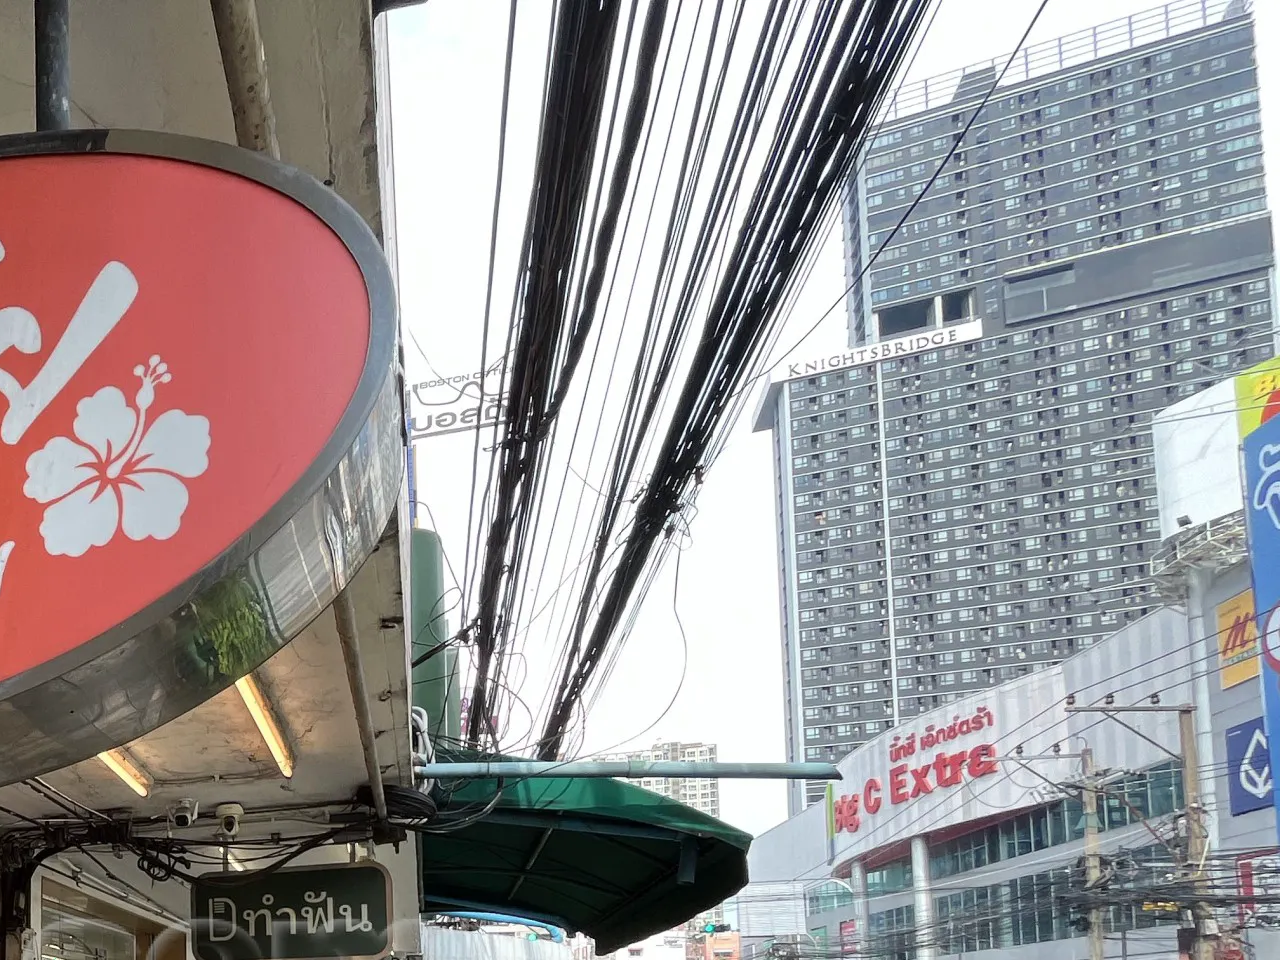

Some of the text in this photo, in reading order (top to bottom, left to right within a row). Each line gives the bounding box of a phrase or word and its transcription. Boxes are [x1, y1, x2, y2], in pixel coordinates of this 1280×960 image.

[787, 329, 958, 378] KNIGHTSBRIDGE
[420, 373, 470, 389] BOSTON
[863, 778, 882, 815] C
[889, 743, 999, 805] Extra
[243, 891, 373, 936] ทำฟัน
